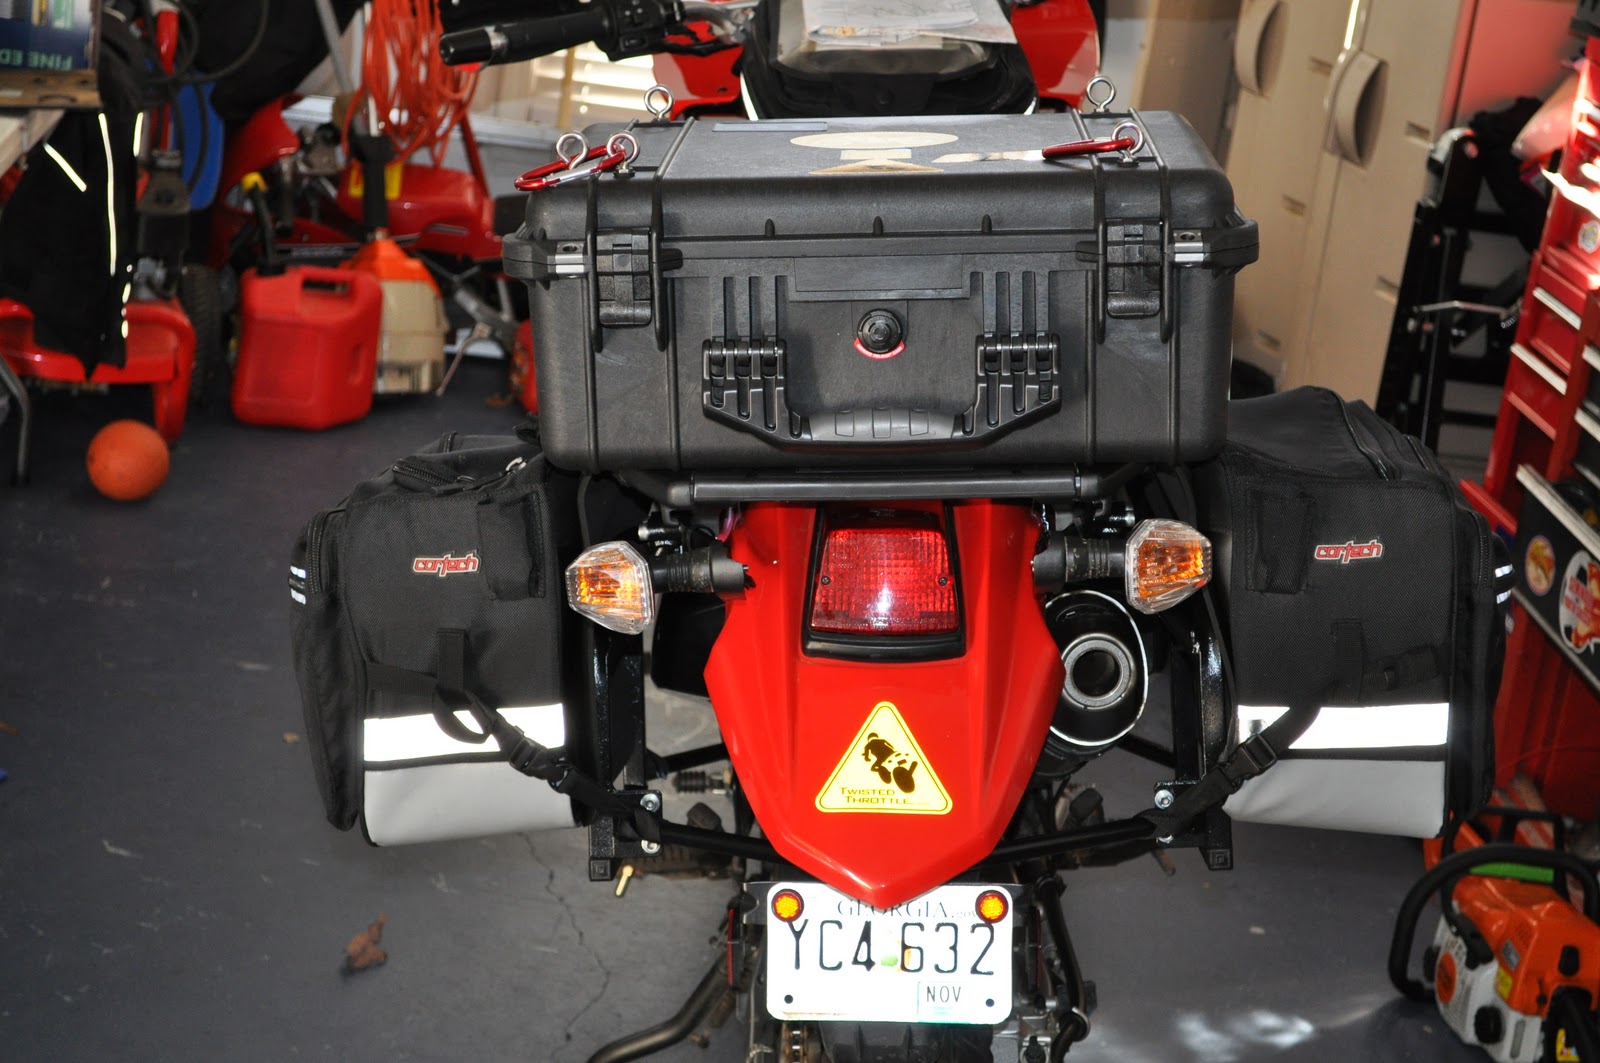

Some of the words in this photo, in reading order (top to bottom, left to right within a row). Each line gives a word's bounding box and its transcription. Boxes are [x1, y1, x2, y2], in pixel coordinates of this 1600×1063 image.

[1315, 539, 1383, 564] cortech
[413, 553, 479, 577] cortech
[926, 985, 963, 1004] NOV
